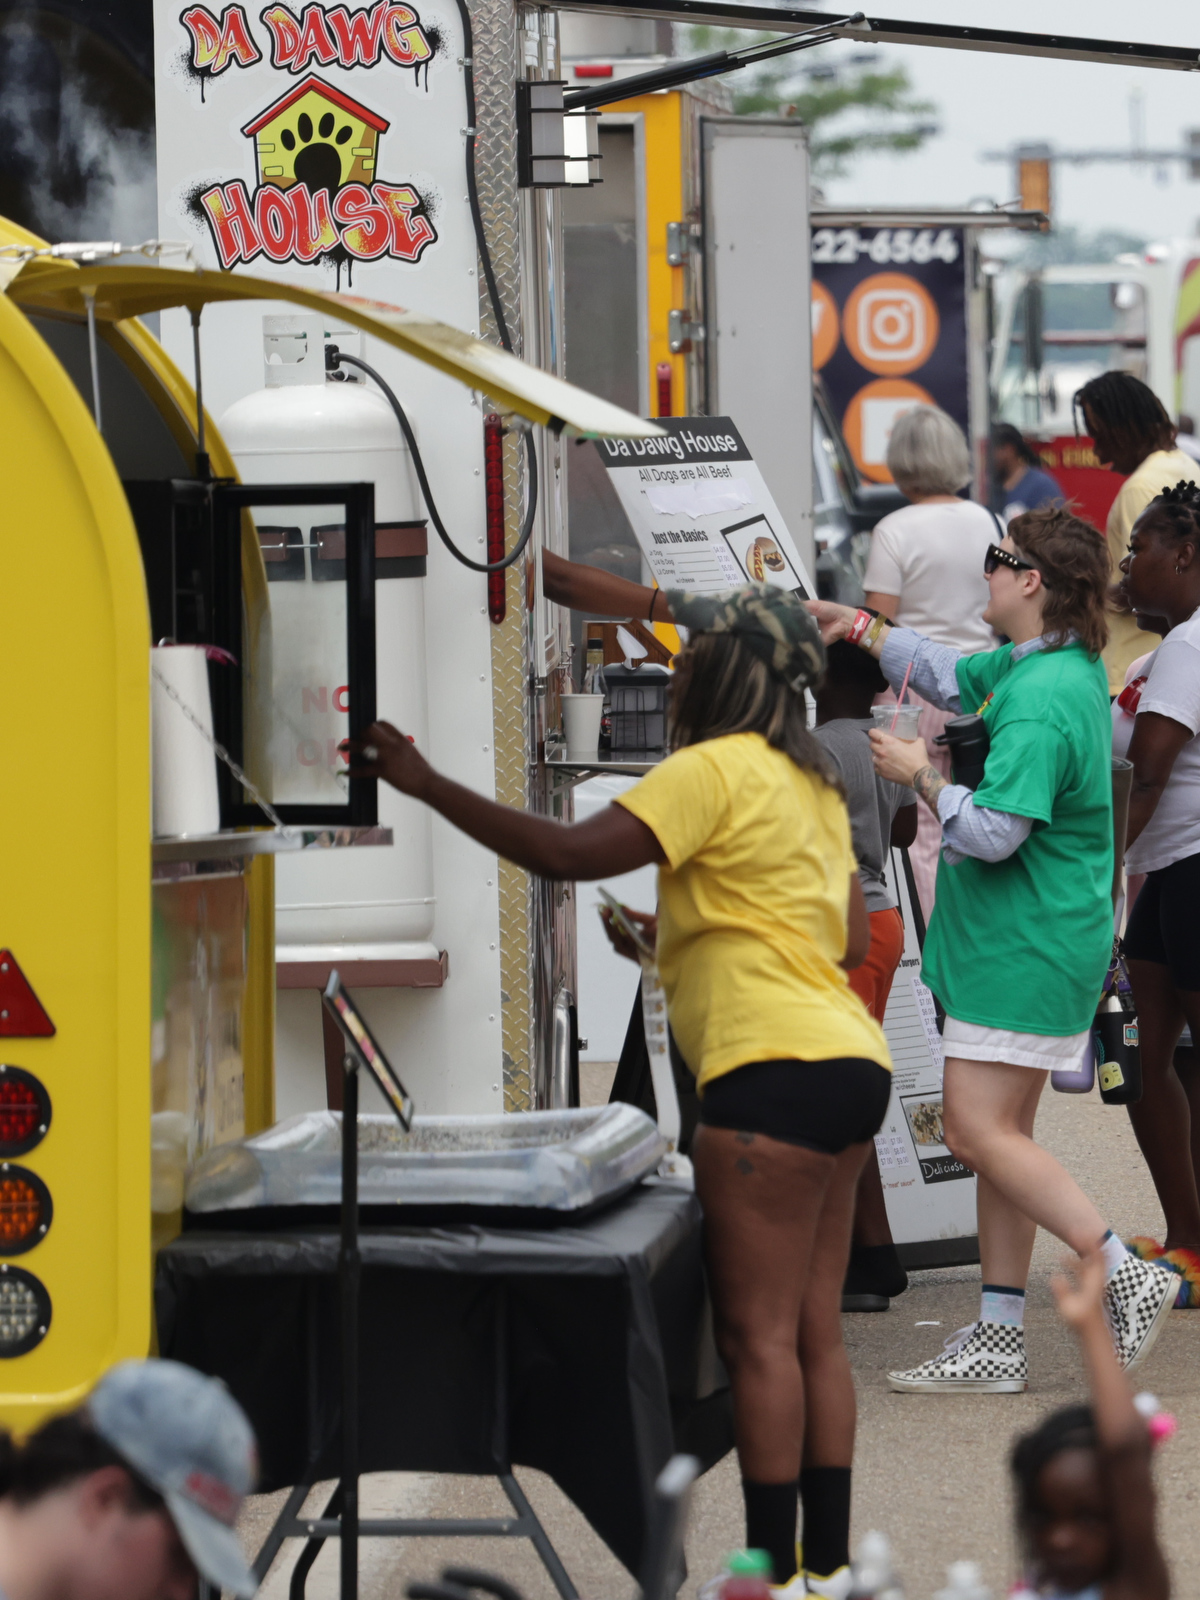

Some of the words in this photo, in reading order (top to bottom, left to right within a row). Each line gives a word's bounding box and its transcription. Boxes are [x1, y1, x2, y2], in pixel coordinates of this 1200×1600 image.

[181, 5, 261, 74] DA
[263, 2, 432, 73] DAWG
[202, 181, 436, 269] HOUSE
[603, 437, 631, 456] Da
[631, 436, 685, 459] Dawg
[680, 431, 738, 453] House
[639, 469, 652, 482] All
[651, 468, 678, 483] Dogs
[680, 469, 694, 480] are
[696, 466, 709, 479] All
[709, 465, 732, 479] Beef
[652, 531, 669, 544] Just
[668, 531, 682, 543] the
[680, 529, 708, 542] Basics
[921, 1161, 964, 1178] Delicioso
